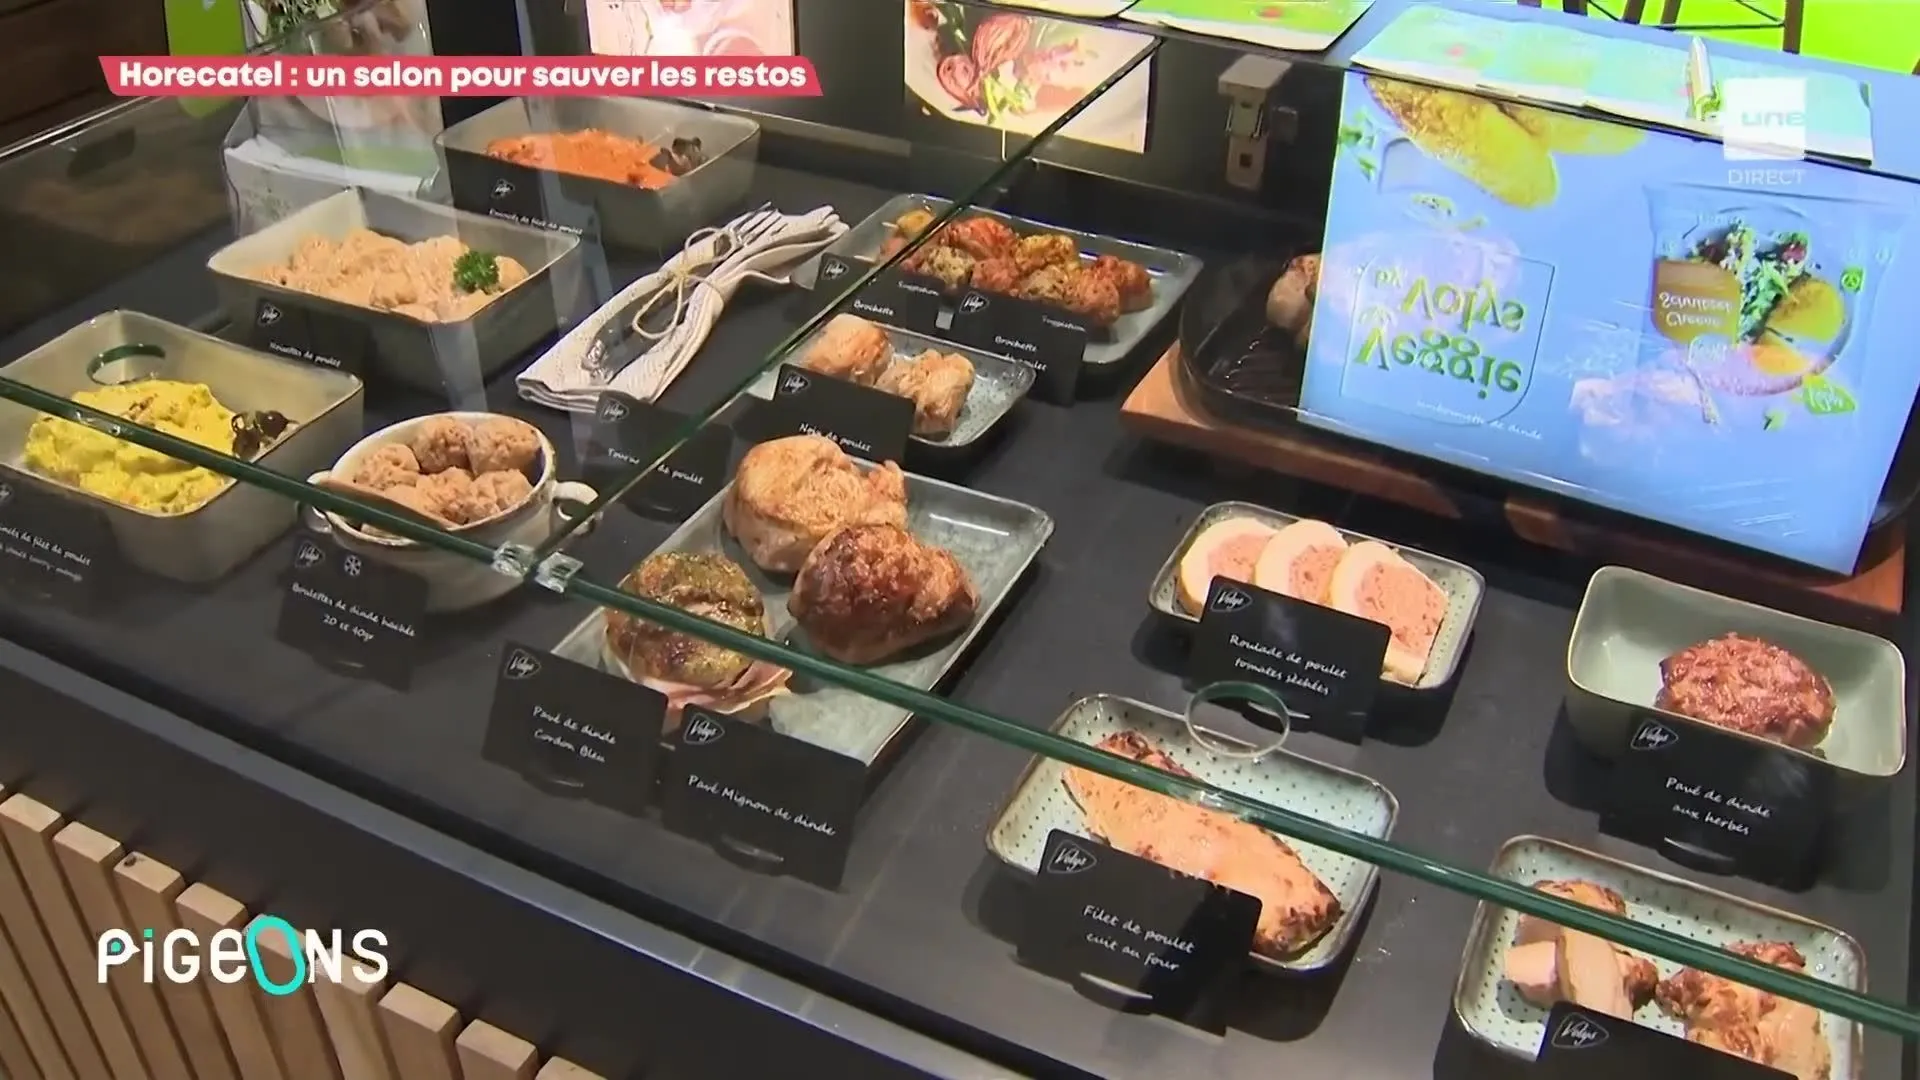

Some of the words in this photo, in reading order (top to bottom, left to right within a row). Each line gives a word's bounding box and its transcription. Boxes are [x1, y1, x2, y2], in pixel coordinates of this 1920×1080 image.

[853, 299, 894, 317] Brochette
[994, 335, 1037, 353] Brochette
[839, 437, 872, 453] poulet
[671, 469, 705, 486] poulet
[63, 550, 92, 567] poulet
[291, 582, 333, 606] Boulettes
[334, 600, 347, 611] de
[348, 605, 379, 623] dinde
[1217, 591, 1245, 611] Volys
[323, 613, 338, 626] 20
[339, 622, 349, 632] et
[1229, 633, 1284, 660] Roulade
[1285, 651, 1303, 665] de
[1304, 660, 1348, 680] poulet
[1234, 657, 1283, 681] tomates
[563, 718, 579, 731] de
[580, 724, 617, 745] dinde
[689, 719, 717, 743] Volys
[1637, 727, 1670, 747] Volys
[534, 729, 576, 752] Cordon
[578, 744, 606, 763] Bleu
[688, 774, 720, 795] Pavé
[720, 787, 773, 814] Mignon
[773, 806, 793, 821] de
[793, 813, 837, 837] dinde
[1665, 776, 1702, 797] Pavé
[1703, 789, 1724, 804] de
[1725, 796, 1773, 819] dinde
[1672, 803, 1701, 820] aux
[1703, 811, 1751, 836] herbes
[1054, 847, 1089, 872] Volys
[1083, 904, 1120, 927] Filet
[1121, 919, 1143, 935] de
[1143, 929, 1196, 954] poulet
[1085, 932, 1119, 951] cuit
[1121, 945, 1141, 960] au
[1143, 951, 1181, 972] four
[1560, 1020, 1600, 1047] Volys
